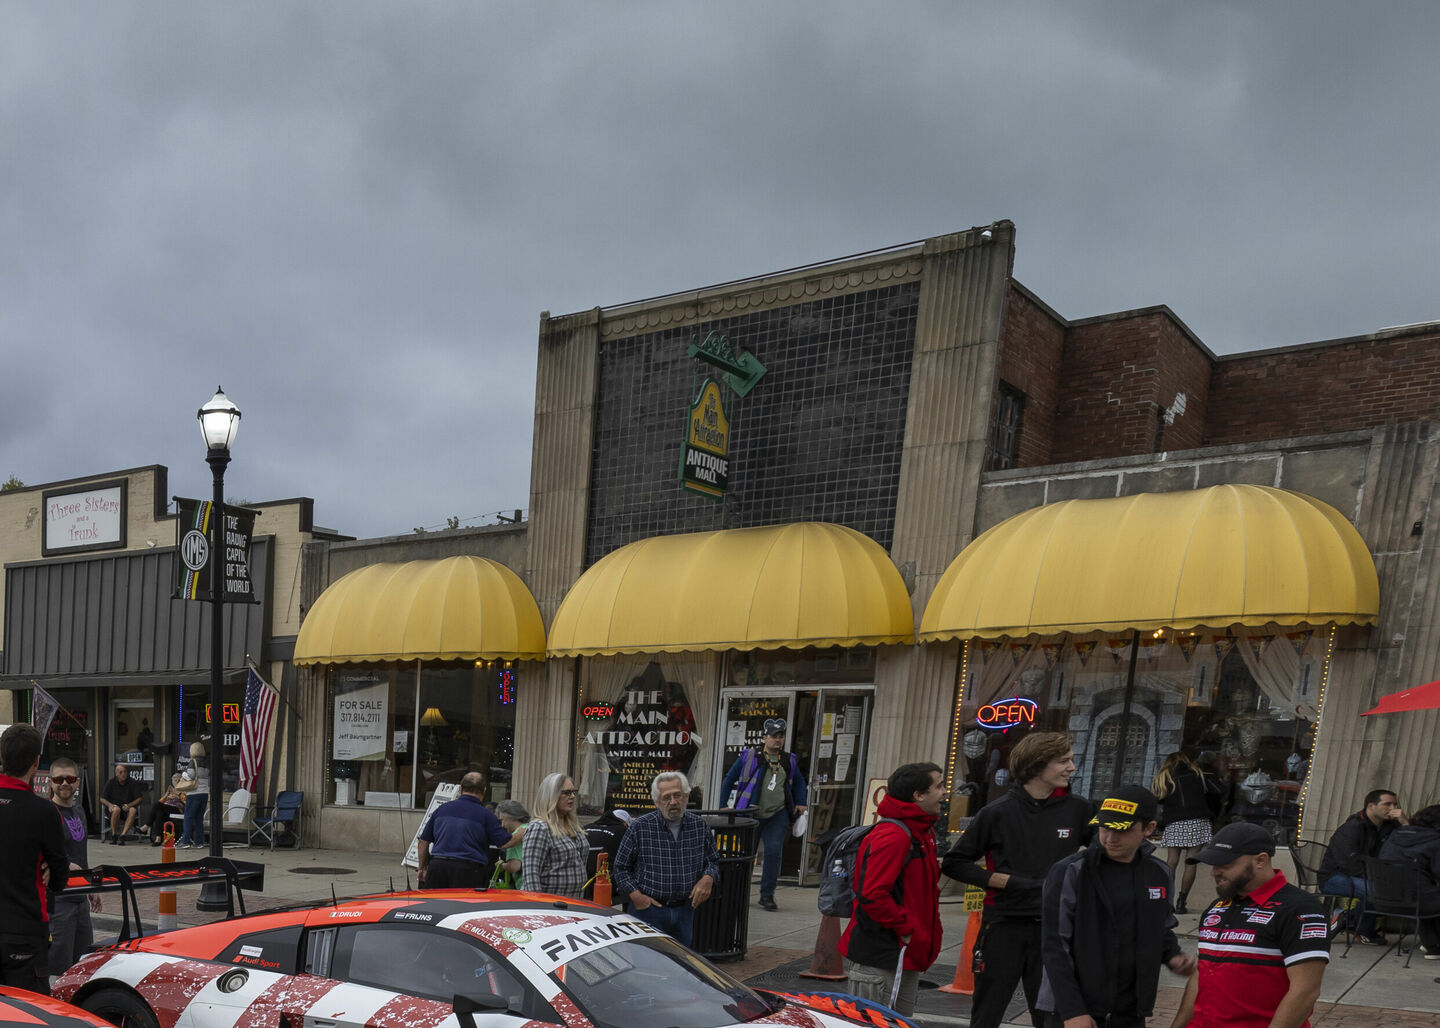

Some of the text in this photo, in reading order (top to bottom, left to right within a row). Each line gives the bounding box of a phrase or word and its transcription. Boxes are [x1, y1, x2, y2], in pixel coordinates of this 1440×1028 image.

[686, 449, 728, 478] ANTIQUE
[695, 466, 717, 484] MALL
[49, 497, 120, 521] Three Sisters
[226, 515, 239, 530] THE
[68, 522, 99, 541] Trunk
[227, 563, 247, 578] OF THE
[226, 580, 250, 593] WORLD
[503, 673, 511, 703] OPEN
[625, 690, 663, 705] THE
[340, 700, 383, 711] FOR SALE
[583, 706, 614, 717] OPEN
[340, 712, 381, 723] 317.814.2111
[616, 710, 670, 725] MAIN
[977, 705, 1035, 723] OPEN
[349, 733, 382, 741] Baumgartner
[581, 731, 703, 745] ATTRACTION
[607, 750, 673, 758] ANTIQUE MALL
[404, 913, 433, 921] FRIJNS
[470, 926, 502, 944] MÜLLER
[1228, 931, 1255, 942] Racing
[242, 956, 280, 968] Audi Sport
